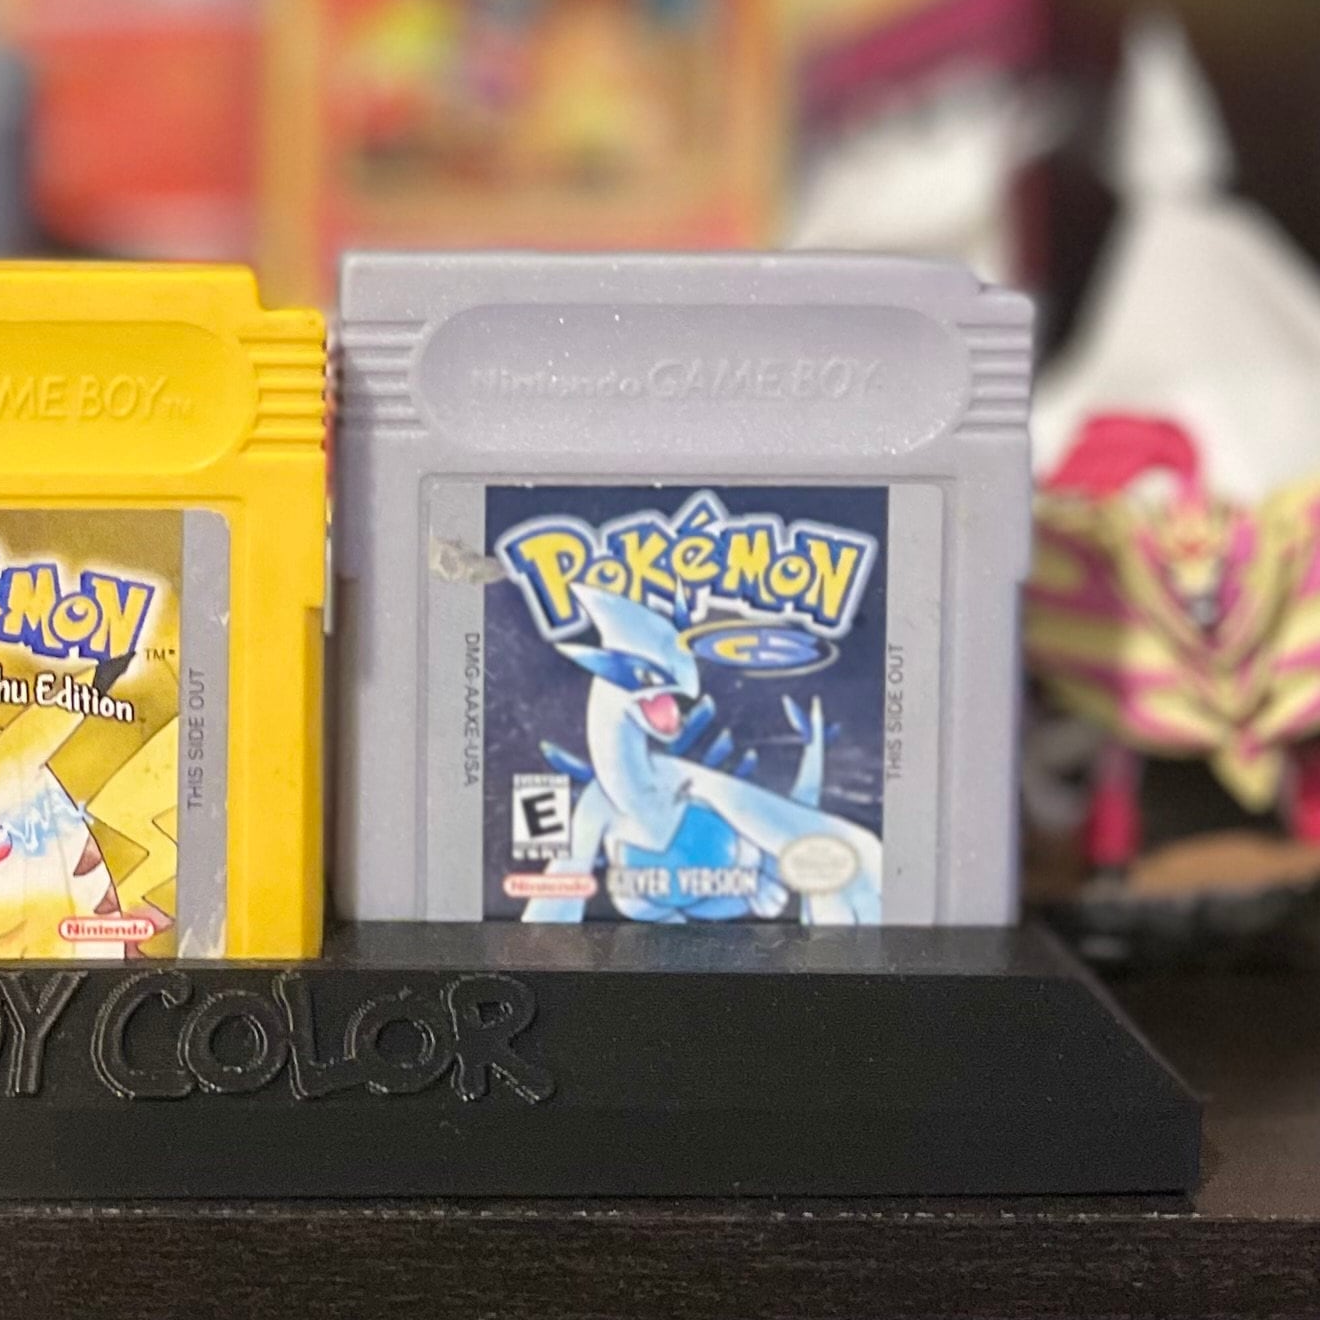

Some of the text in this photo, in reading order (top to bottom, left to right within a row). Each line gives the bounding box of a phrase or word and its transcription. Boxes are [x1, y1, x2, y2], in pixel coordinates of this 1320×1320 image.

[34, 669, 135, 723] Edition
[187, 667, 205, 811] THIS SIDE OUT
[887, 643, 903, 780] THIS SIDE OUT
[521, 790, 565, 839] E
[66, 923, 150, 936] Nintendo
[91, 970, 556, 1105] COLOR
